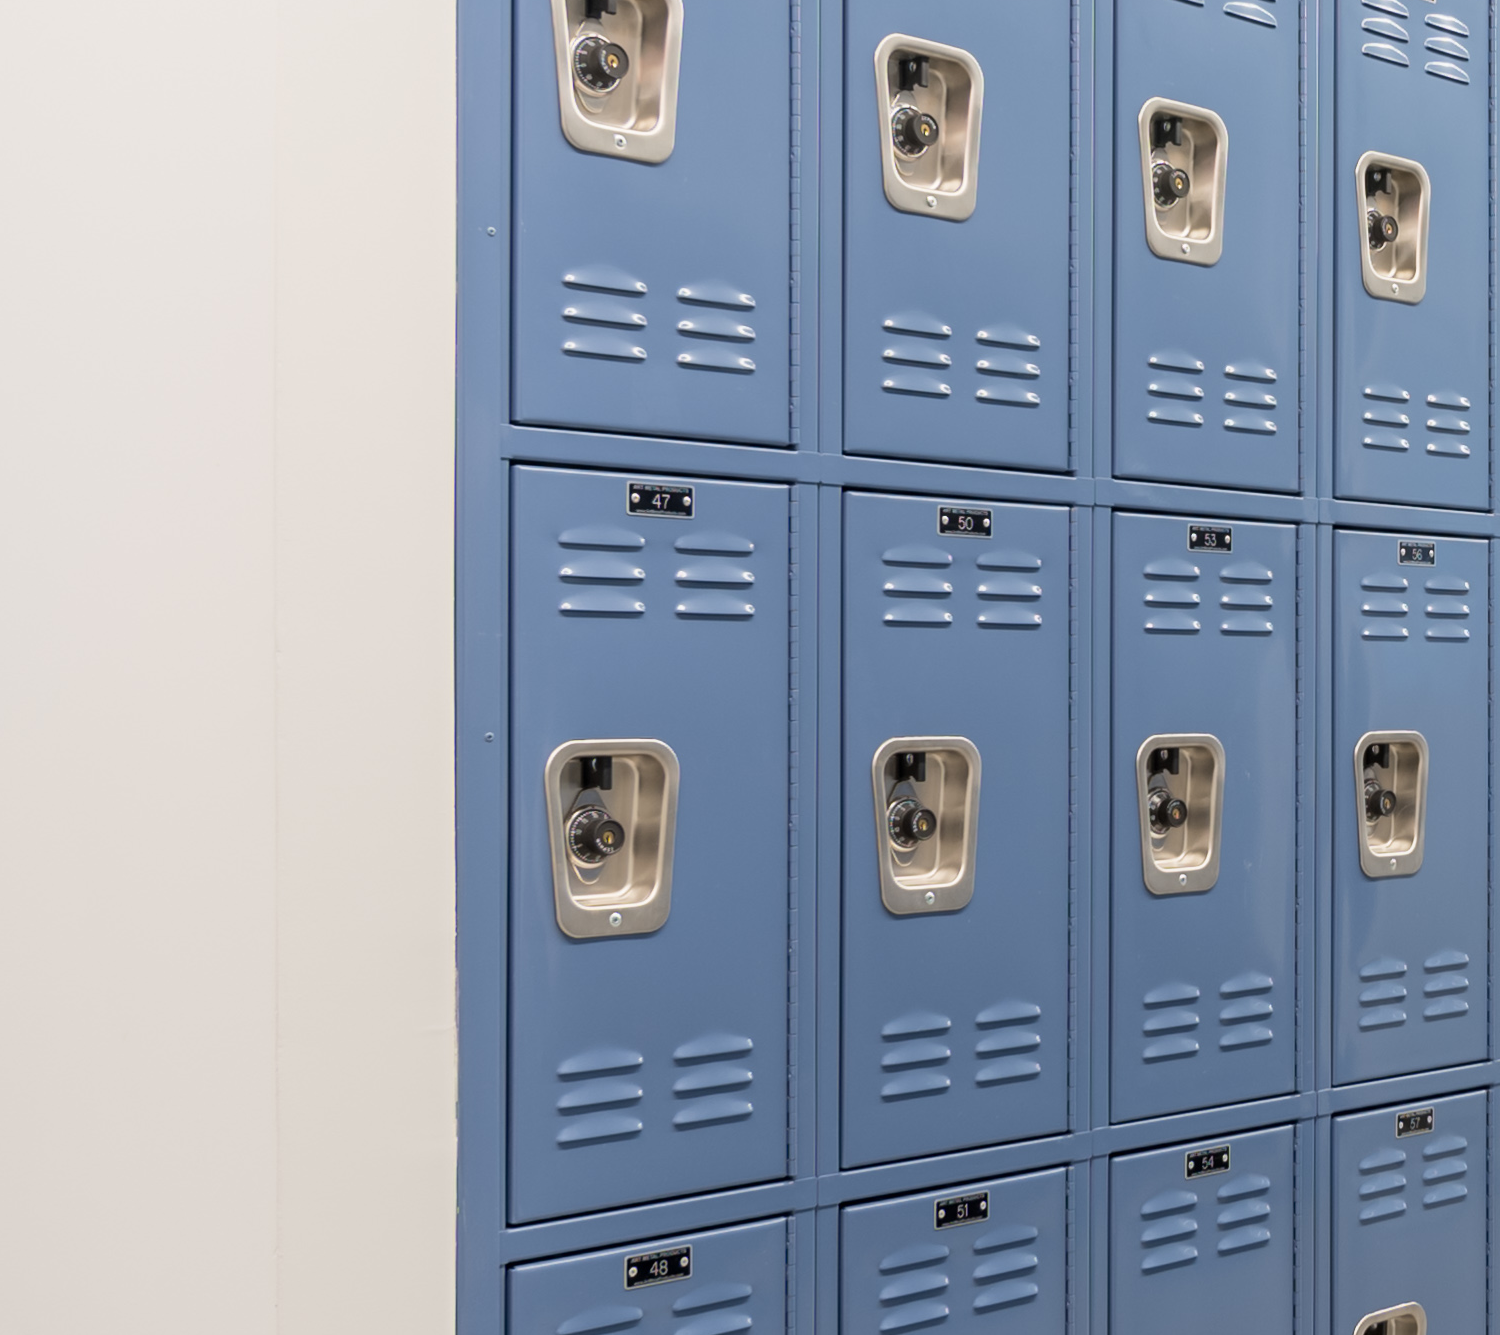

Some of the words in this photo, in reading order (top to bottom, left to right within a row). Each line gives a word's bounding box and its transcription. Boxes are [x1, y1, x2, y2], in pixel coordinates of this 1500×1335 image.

[651, 493, 671, 510] 47
[957, 515, 974, 531] 50
[1203, 532, 1218, 547] 53
[1411, 548, 1423, 561] 56
[1409, 1116, 1421, 1130] 57
[1202, 1154, 1215, 1170] 54
[956, 1202, 969, 1219] 51
[649, 1259, 669, 1277] 48
